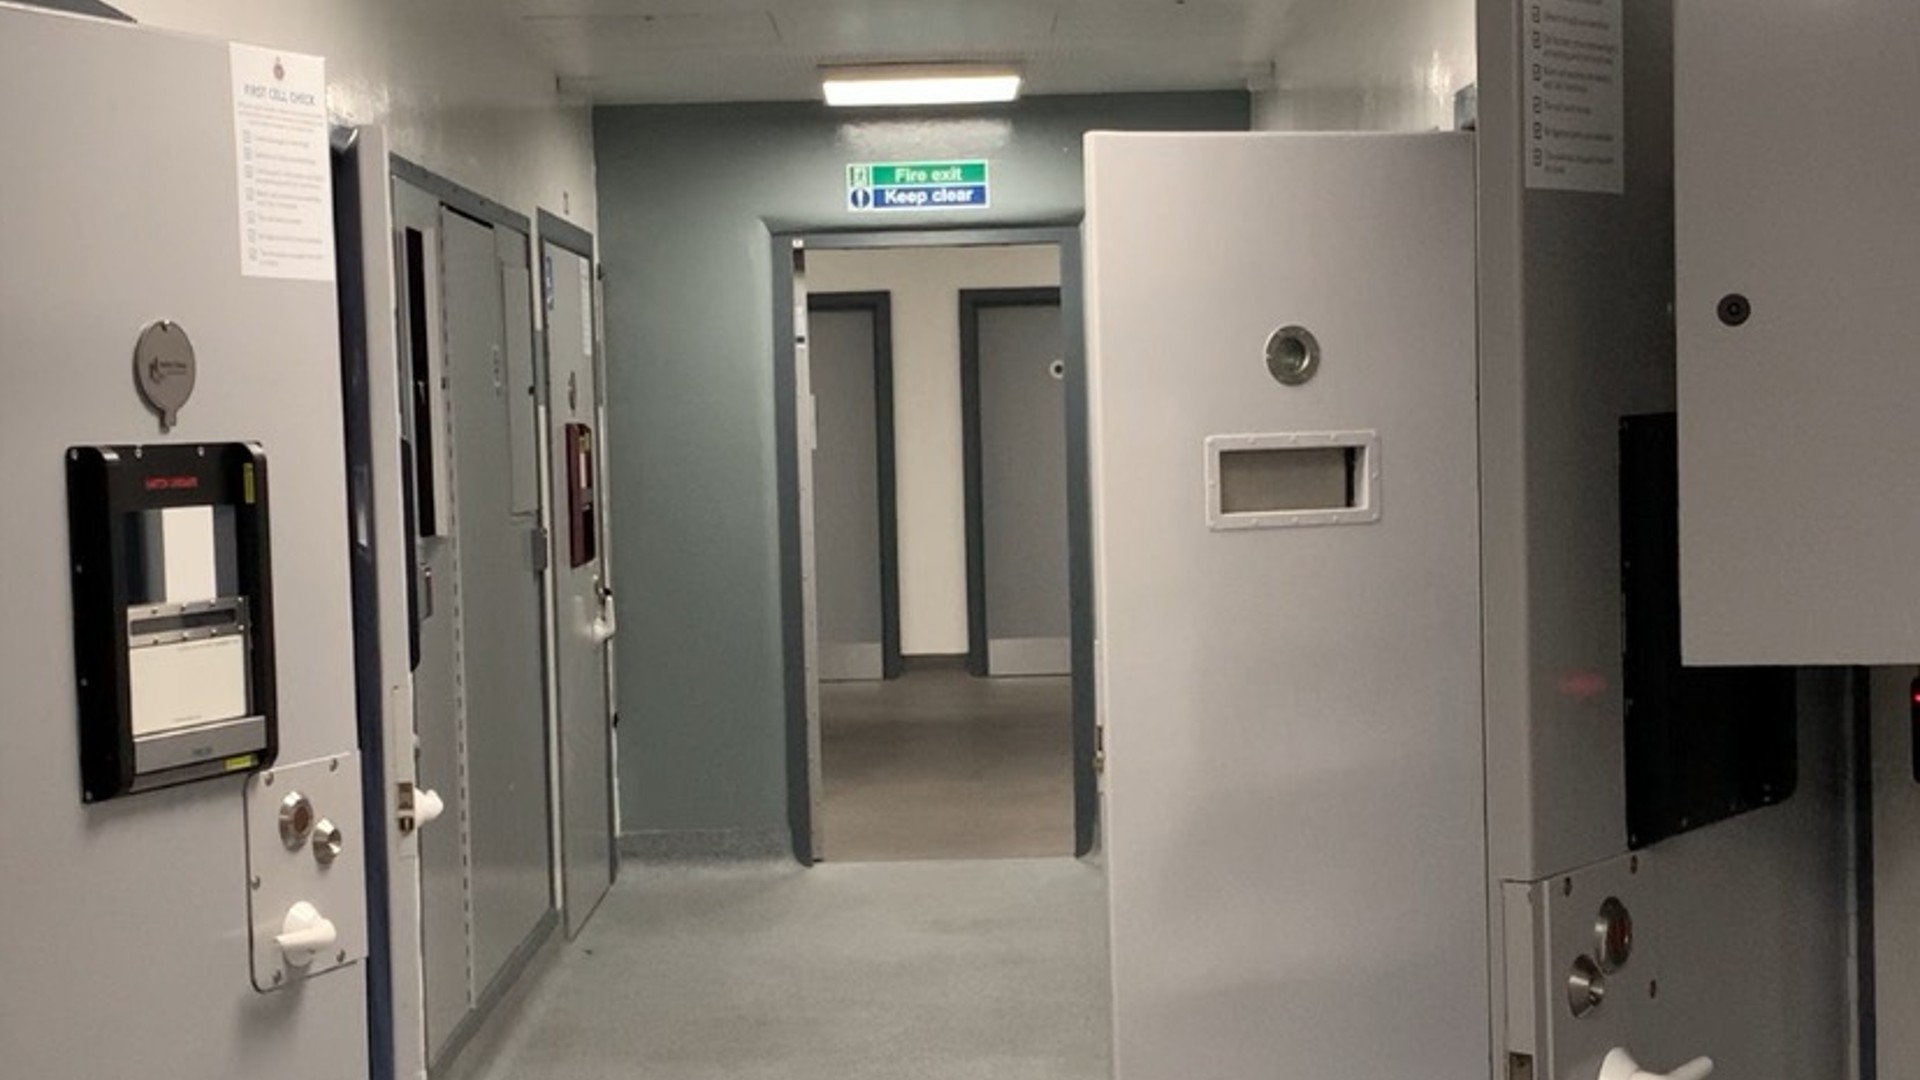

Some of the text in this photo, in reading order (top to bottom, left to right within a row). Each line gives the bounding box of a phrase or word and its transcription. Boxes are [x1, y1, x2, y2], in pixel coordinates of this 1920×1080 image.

[895, 166, 963, 182] Fire exit
[885, 189, 974, 205] Keep clear
